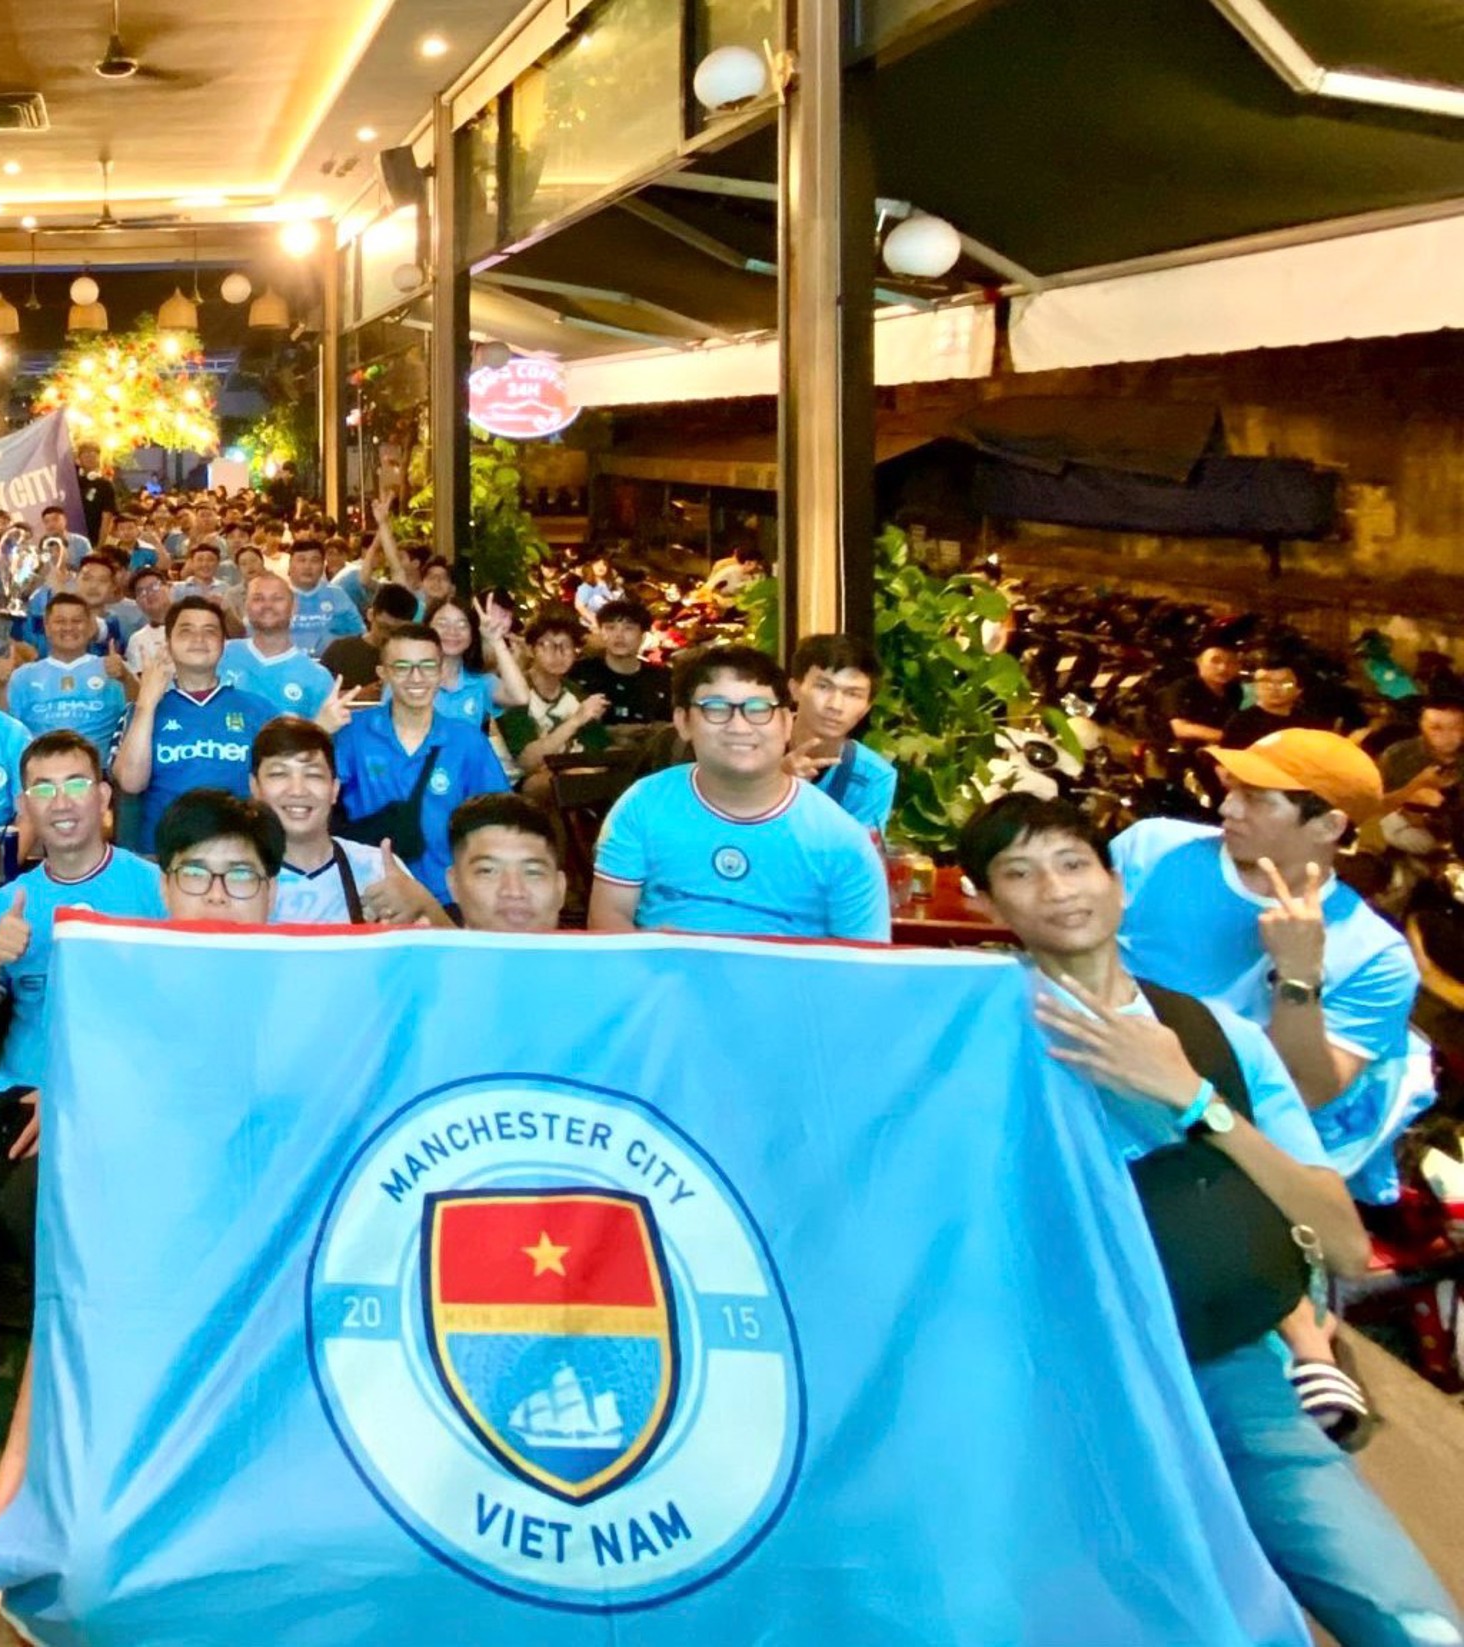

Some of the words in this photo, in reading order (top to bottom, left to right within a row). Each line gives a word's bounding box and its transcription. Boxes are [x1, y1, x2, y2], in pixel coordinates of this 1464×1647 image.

[9, 464, 65, 508] CITY,
[156, 738, 250, 764] brother
[379, 1110, 613, 1203] MANCHESTER
[625, 1140, 697, 1207] CITY
[342, 1296, 381, 1328] 20
[722, 1304, 761, 1340] 15
[476, 1493, 572, 1564] VIET
[591, 1501, 693, 1568] NAM
